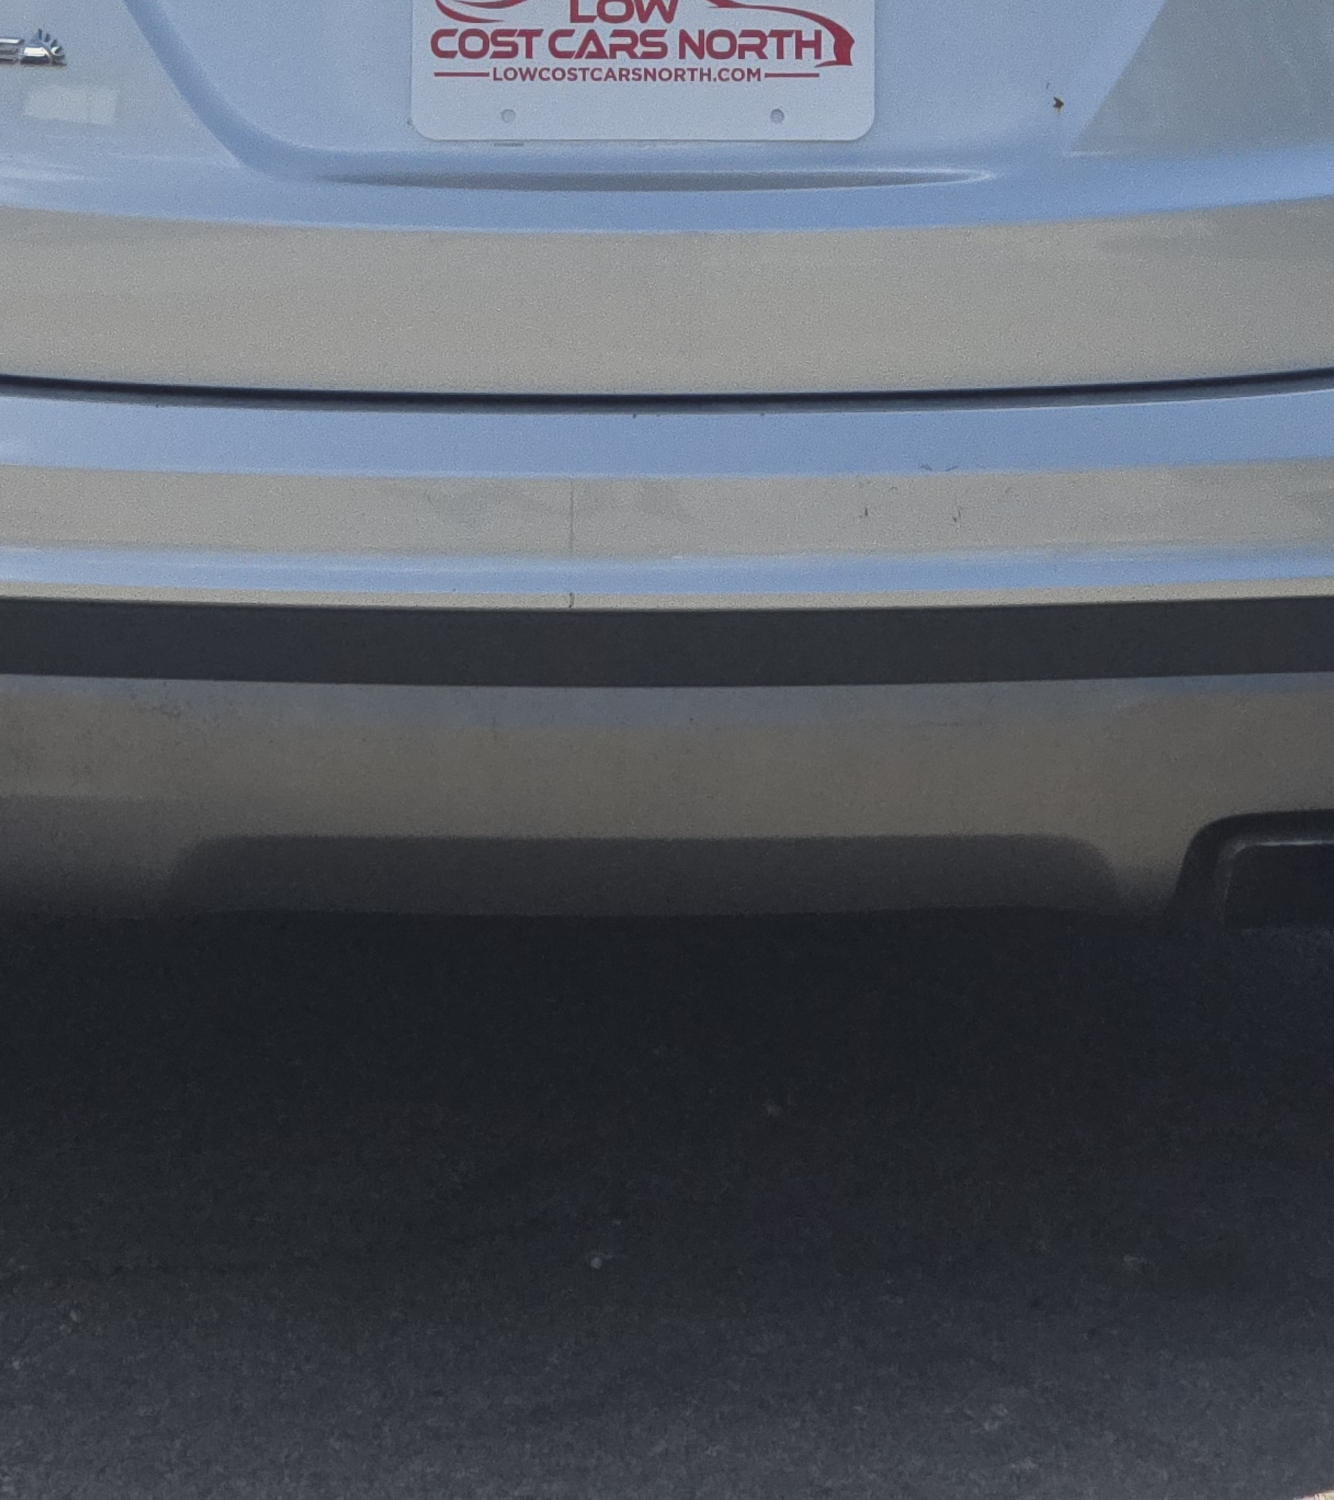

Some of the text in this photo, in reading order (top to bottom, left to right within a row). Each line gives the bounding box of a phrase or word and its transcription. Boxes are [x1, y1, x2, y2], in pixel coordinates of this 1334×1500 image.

[430, 28, 823, 61] COST CARS NORTH
[492, 67, 762, 83] LOWCOSTCARSNORTH.COM
